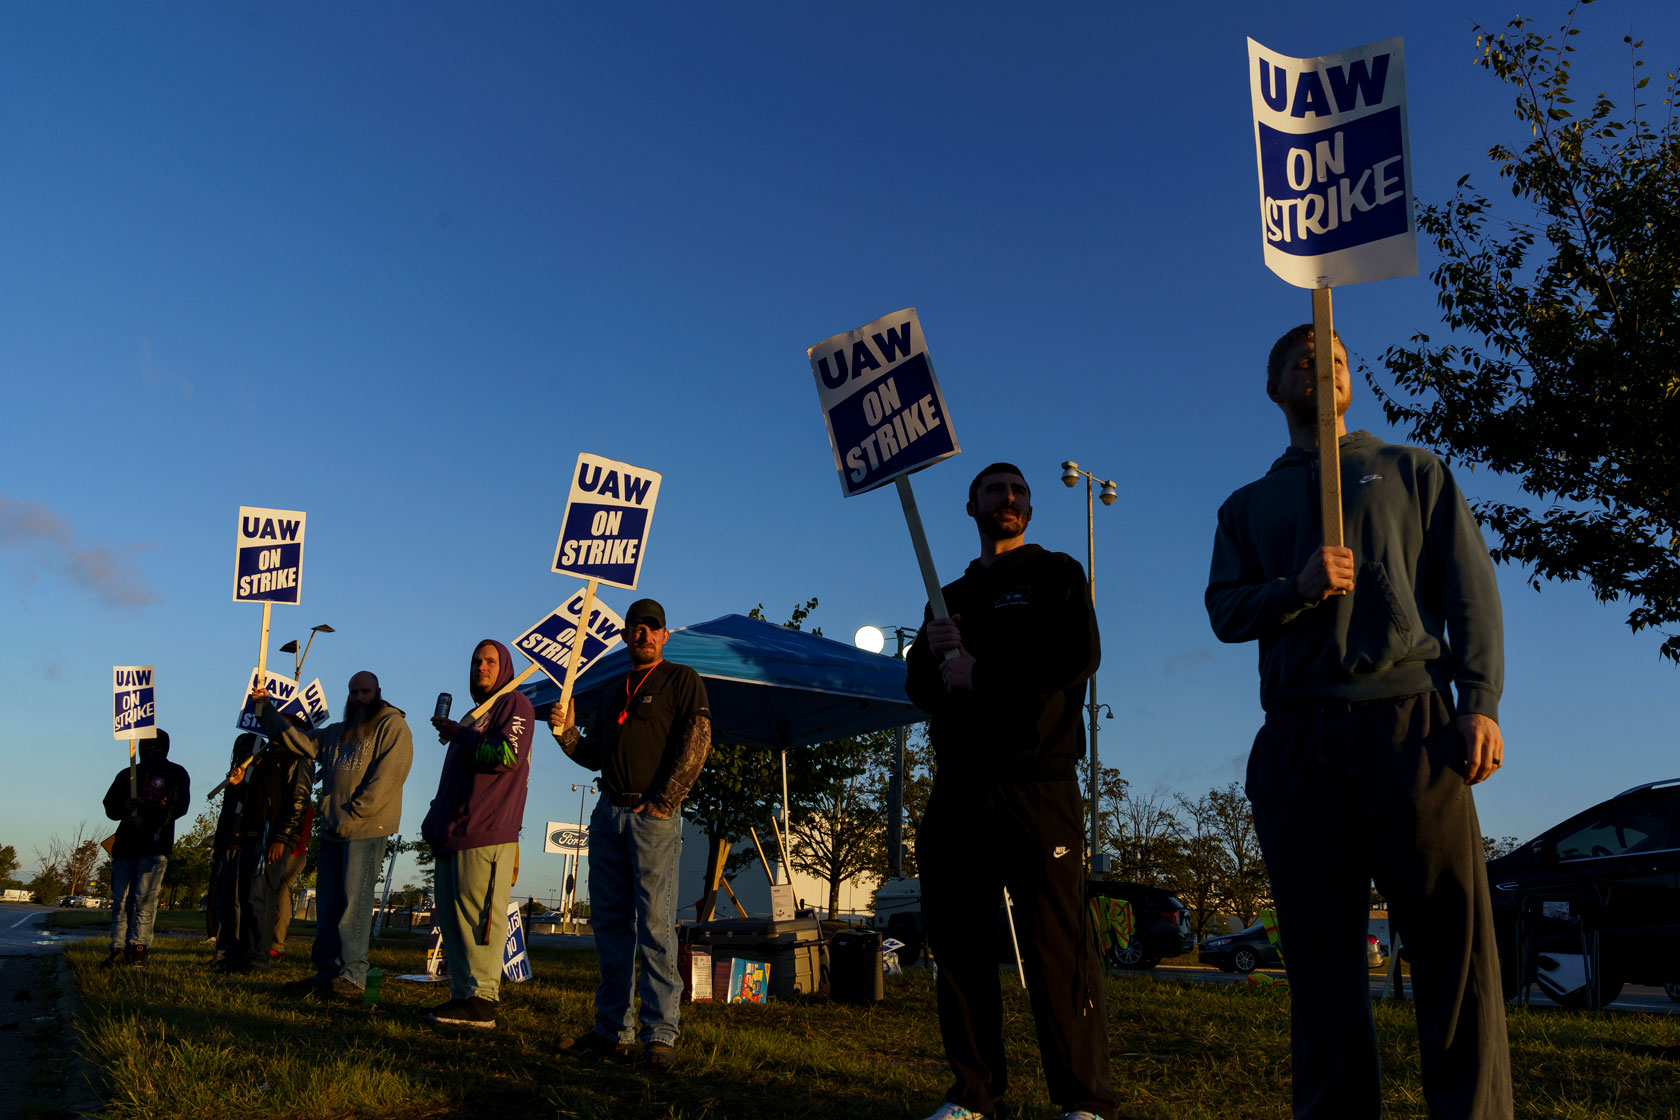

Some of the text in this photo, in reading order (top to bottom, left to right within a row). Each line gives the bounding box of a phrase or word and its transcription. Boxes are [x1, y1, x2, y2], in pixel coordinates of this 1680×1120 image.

[1259, 53, 1391, 119] UAW
[1286, 131, 1346, 191] ON
[1265, 154, 1405, 243] STRIKE
[817, 321, 911, 390] UAW
[862, 376, 901, 427] ON
[846, 393, 941, 484] STRIKE
[578, 462, 652, 506] UAW
[242, 516, 301, 541] UAW
[590, 510, 623, 537] ON
[258, 547, 282, 571] ON
[561, 539, 639, 566] STRIKE
[239, 566, 297, 597] STRIKE
[116, 670, 152, 687] UAW
[122, 691, 140, 710] ON
[305, 684, 326, 724] UAW
[115, 702, 154, 731] STRIKE
[558, 831, 588, 847] Ford
